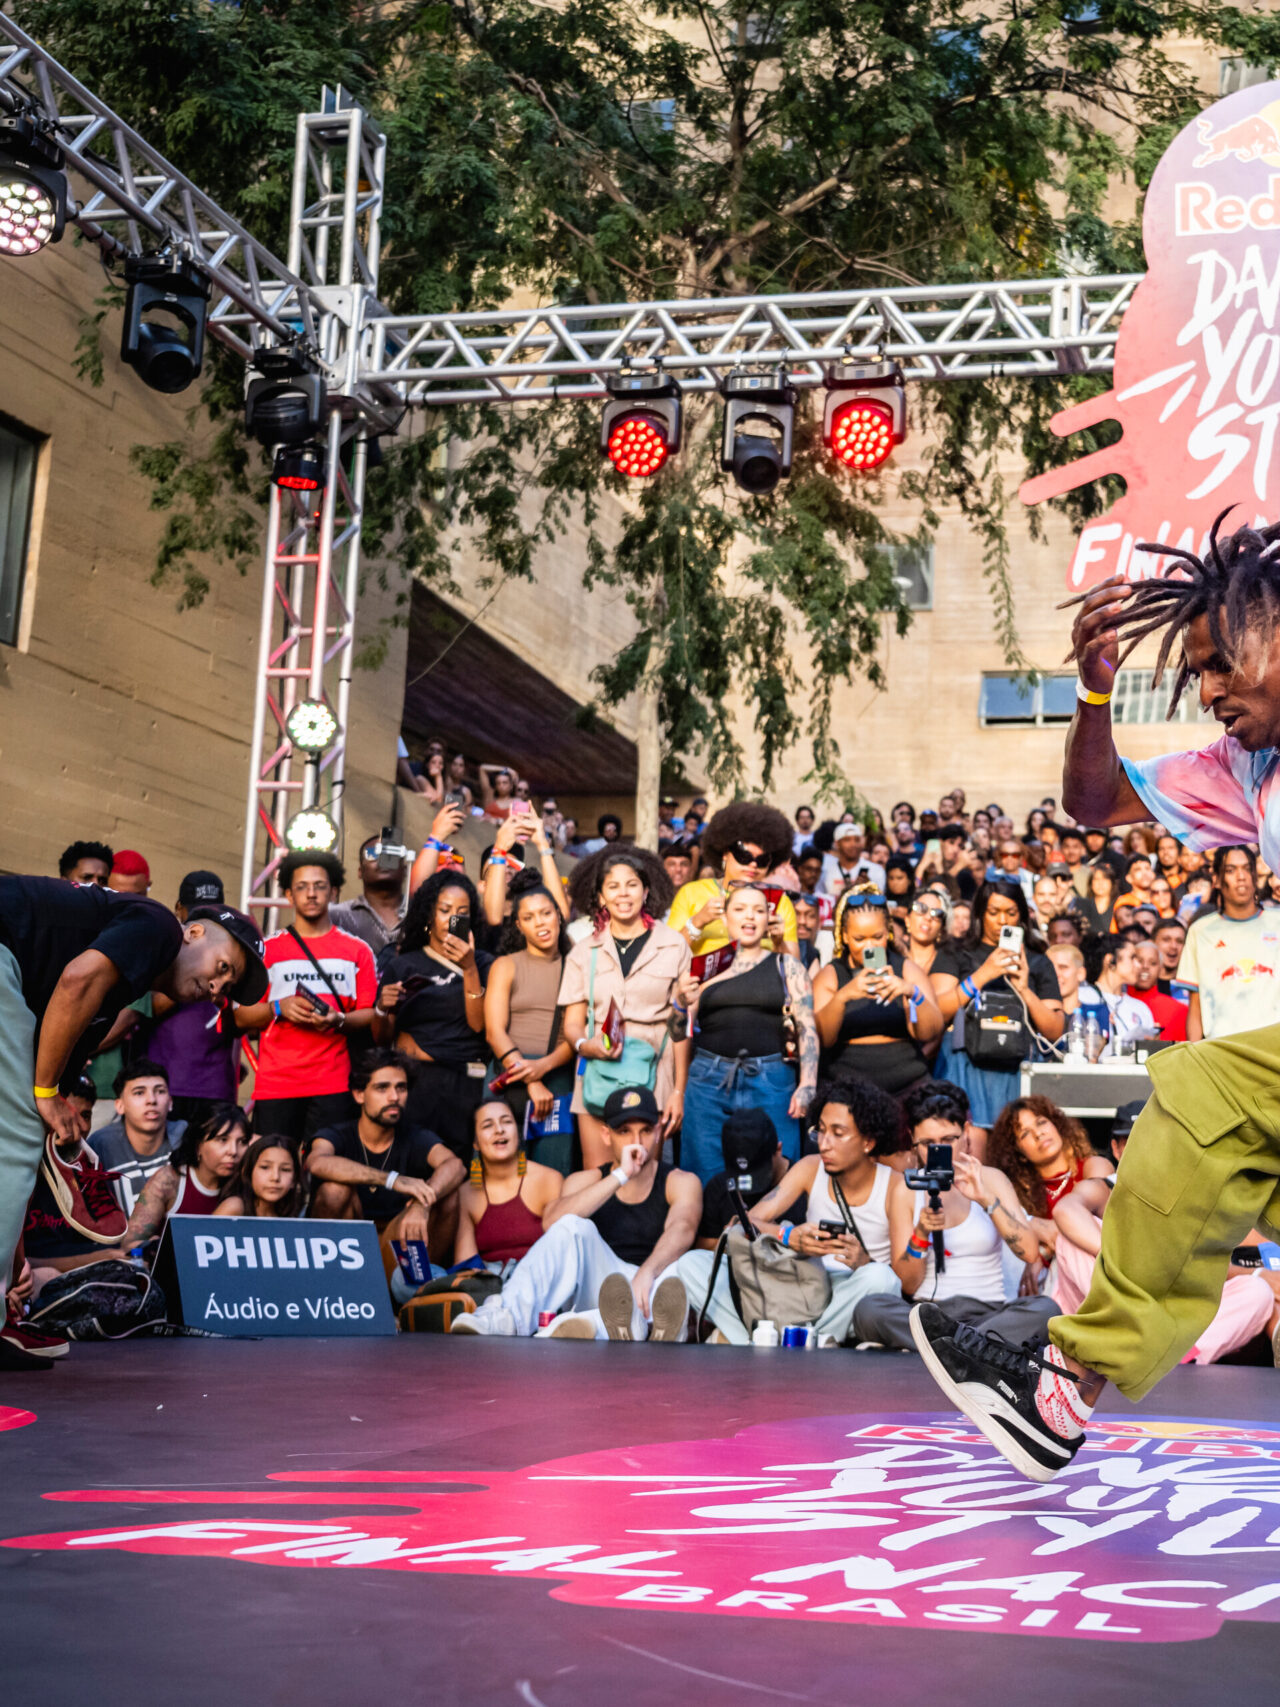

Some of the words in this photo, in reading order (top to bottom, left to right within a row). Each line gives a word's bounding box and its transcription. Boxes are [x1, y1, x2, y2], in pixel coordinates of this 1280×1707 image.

[194, 1235, 365, 1270] PHILIPS
[204, 1293, 280, 1320] Áudio
[285, 1302, 300, 1319] e
[304, 1296, 376, 1319] Vídeo
[66, 1522, 684, 1577] FINAL
[615, 1584, 1141, 1634] BRASIL
